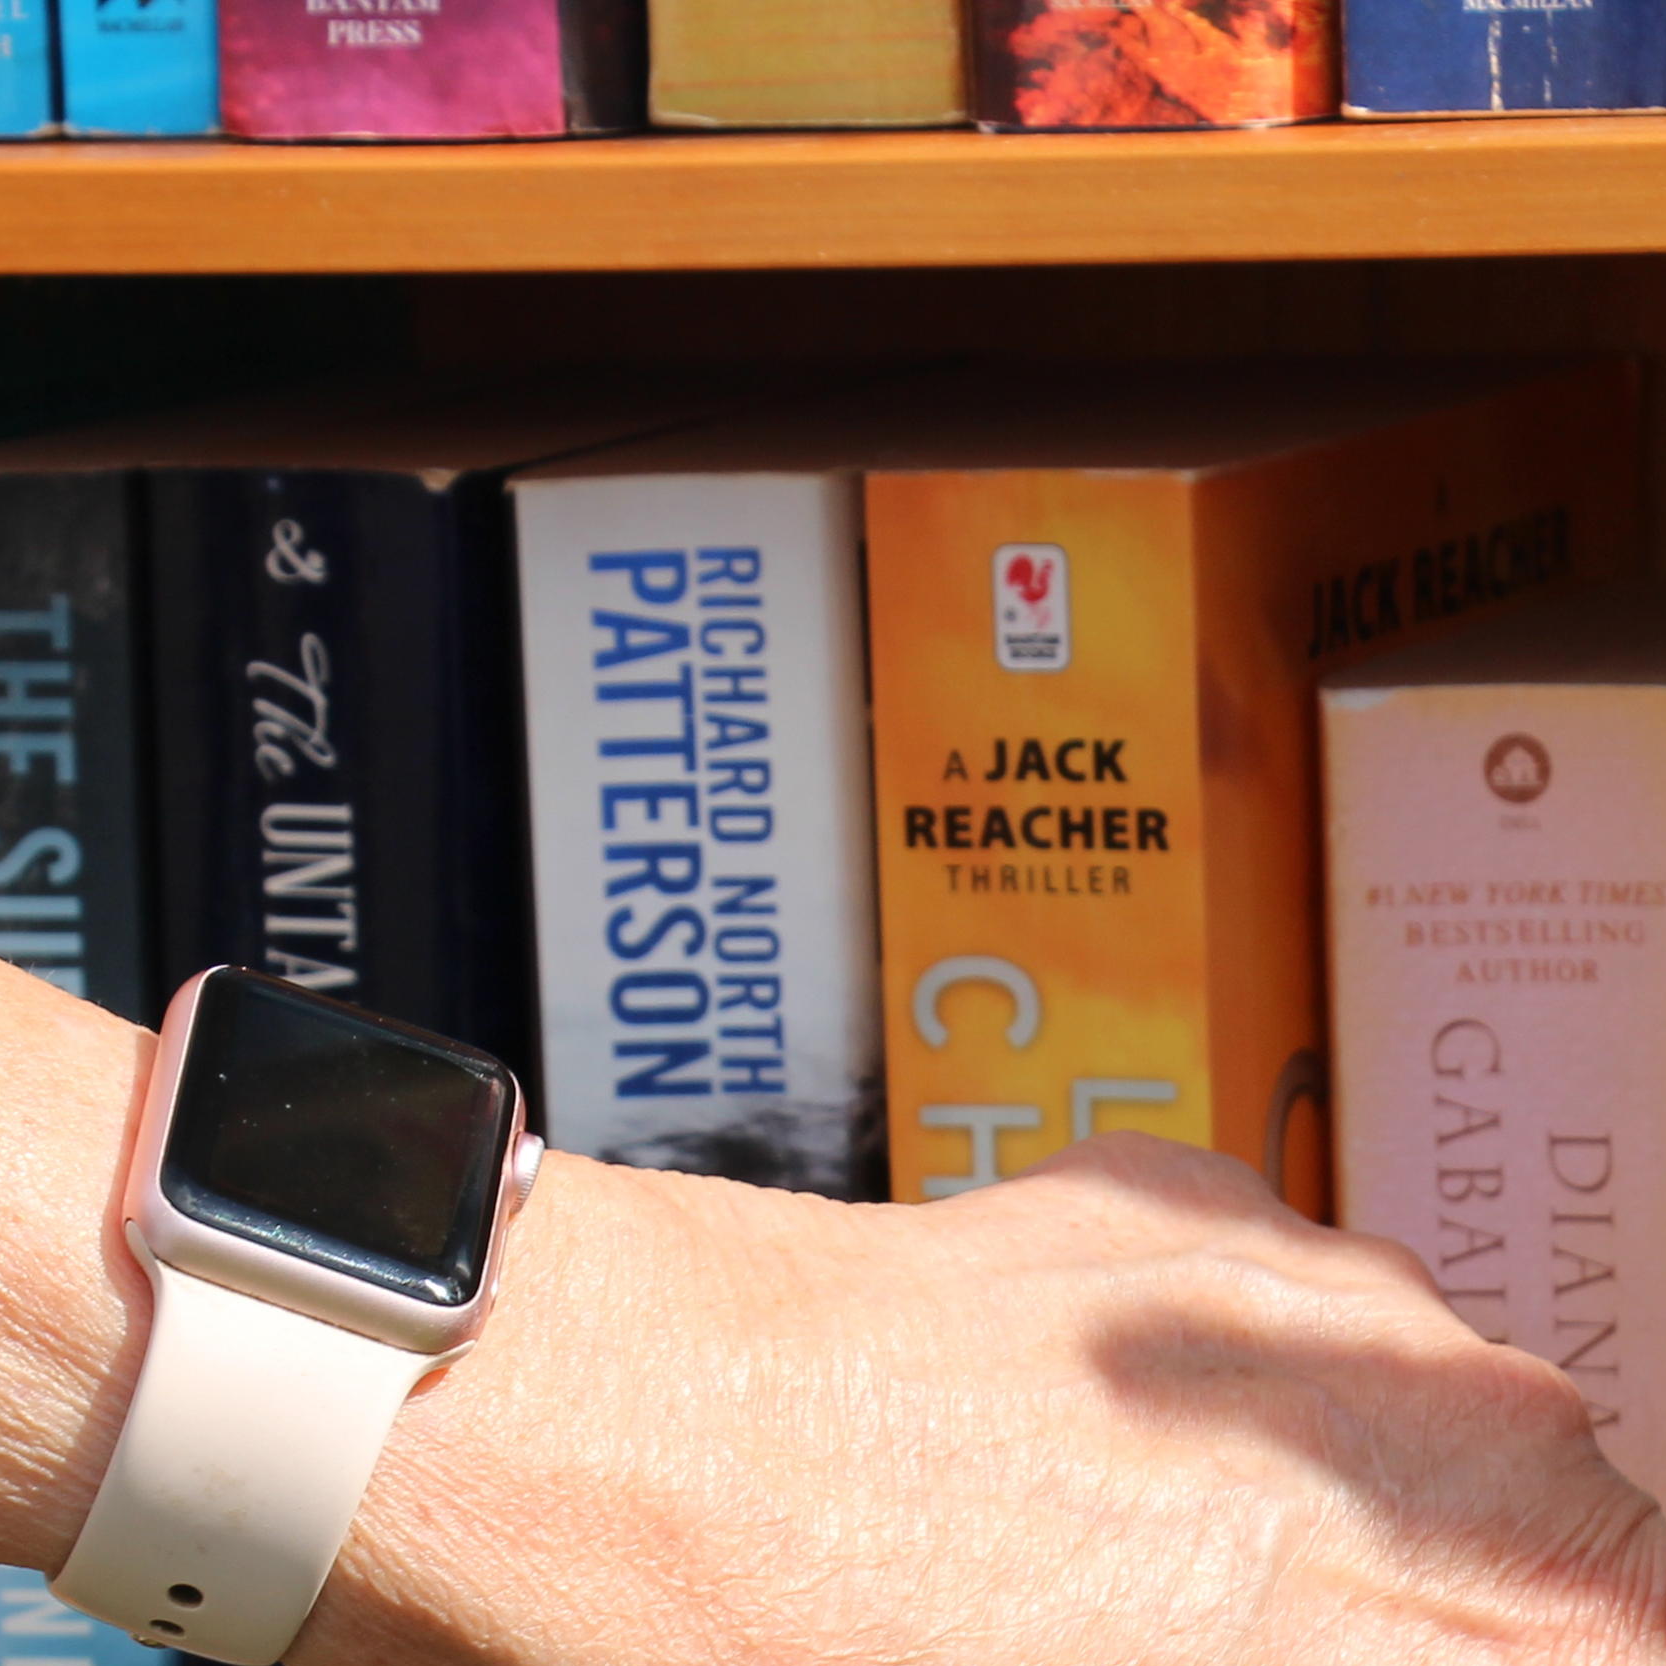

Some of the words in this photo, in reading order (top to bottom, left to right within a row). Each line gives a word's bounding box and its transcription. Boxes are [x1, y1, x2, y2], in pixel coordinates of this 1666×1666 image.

[328, 18, 422, 46] PRESS
[267, 518, 327, 585] &
[1308, 556, 1401, 661] JACK
[695, 546, 775, 845] RICHARD
[943, 749, 968, 782] A
[985, 739, 1130, 784] JACK
[588, 549, 713, 1098] PATTERSON
[905, 805, 1170, 852] REACHER
[945, 863, 1132, 896] THRILLER
[1405, 919, 1646, 948] BESTSELLING
[712, 874, 787, 1096] NORTH
[1456, 957, 1600, 985] AUTHOR
